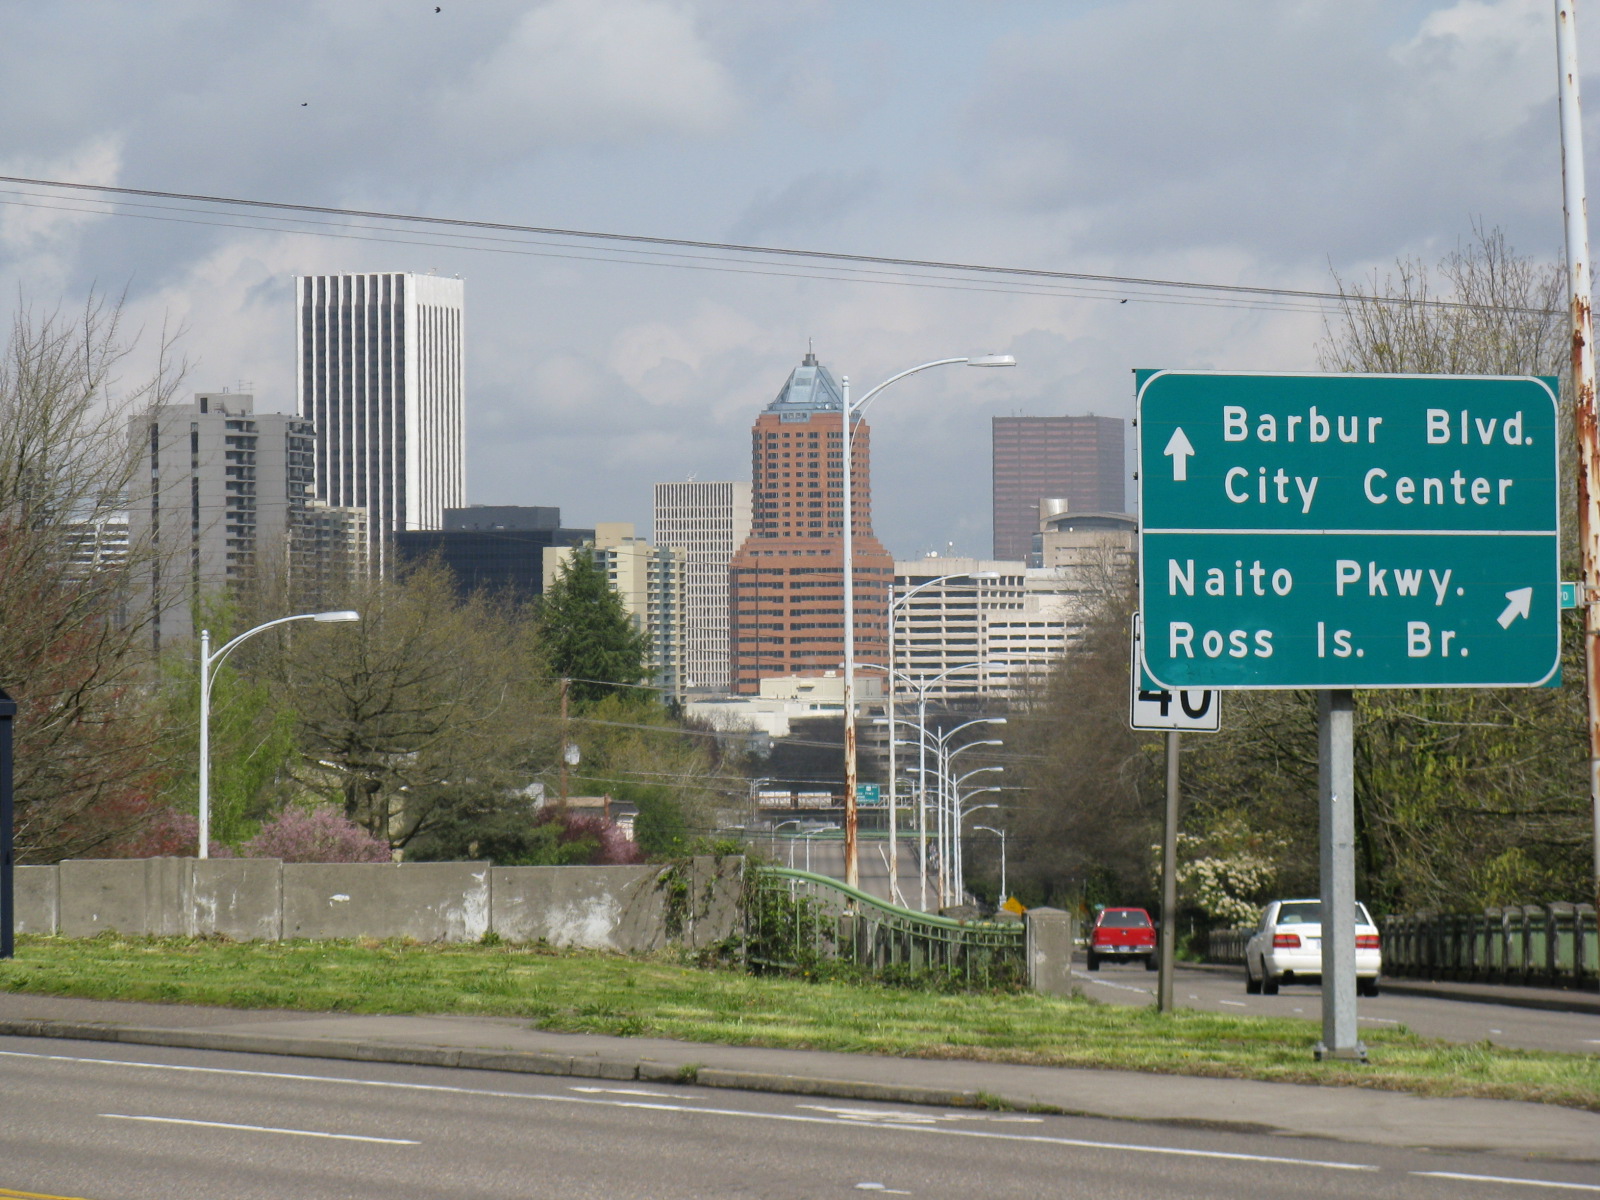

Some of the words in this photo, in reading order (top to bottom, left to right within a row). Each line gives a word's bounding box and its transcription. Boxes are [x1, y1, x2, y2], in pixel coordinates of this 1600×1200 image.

[1223, 406, 1382, 443] Barbur
[1426, 409, 1533, 445] Blvd.
[1225, 467, 1318, 513] City
[1364, 468, 1513, 505] Center
[1168, 559, 1293, 596] Naito
[1336, 560, 1464, 606] Pkwy.
[1170, 622, 1274, 658] Ross
[1317, 622, 1364, 657] Is.
[1407, 622, 1468, 657] Br.
[1138, 690, 1212, 719] 40
